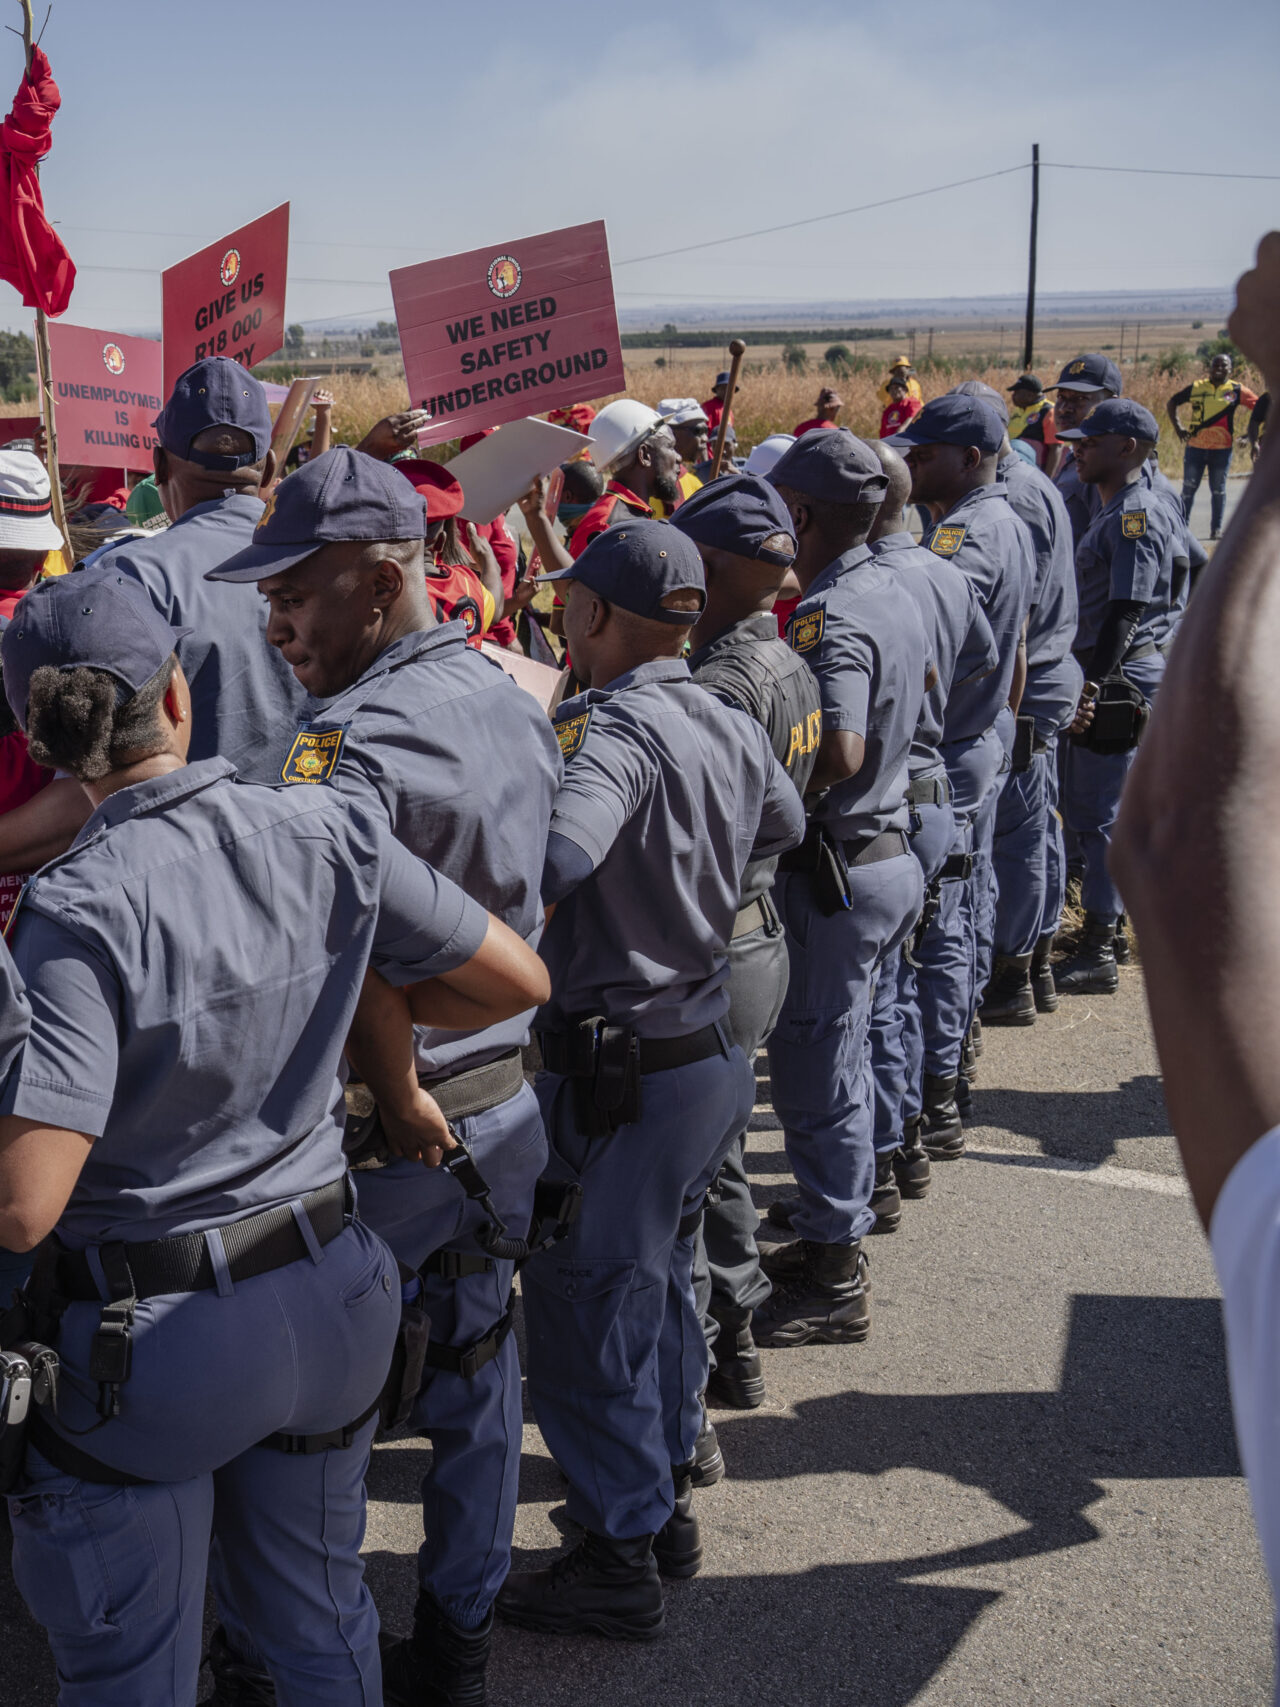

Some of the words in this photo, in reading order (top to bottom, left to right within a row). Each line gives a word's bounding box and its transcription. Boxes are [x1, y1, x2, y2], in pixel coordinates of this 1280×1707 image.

[195, 289, 236, 331] GIVE
[241, 272, 264, 304] US
[445, 316, 485, 345] WE
[491, 297, 557, 333] NEED
[195, 330, 227, 362] R18
[232, 307, 262, 342] 000
[461, 330, 552, 375] SAFETY
[58, 382, 162, 410] UNEMPLOYMEN
[422, 348, 609, 418] UNDERGROUND
[84, 430, 140, 449] KILLING
[143, 436, 161, 451] US
[116, 410, 129, 426] IS
[299, 736, 337, 748] POLICE
